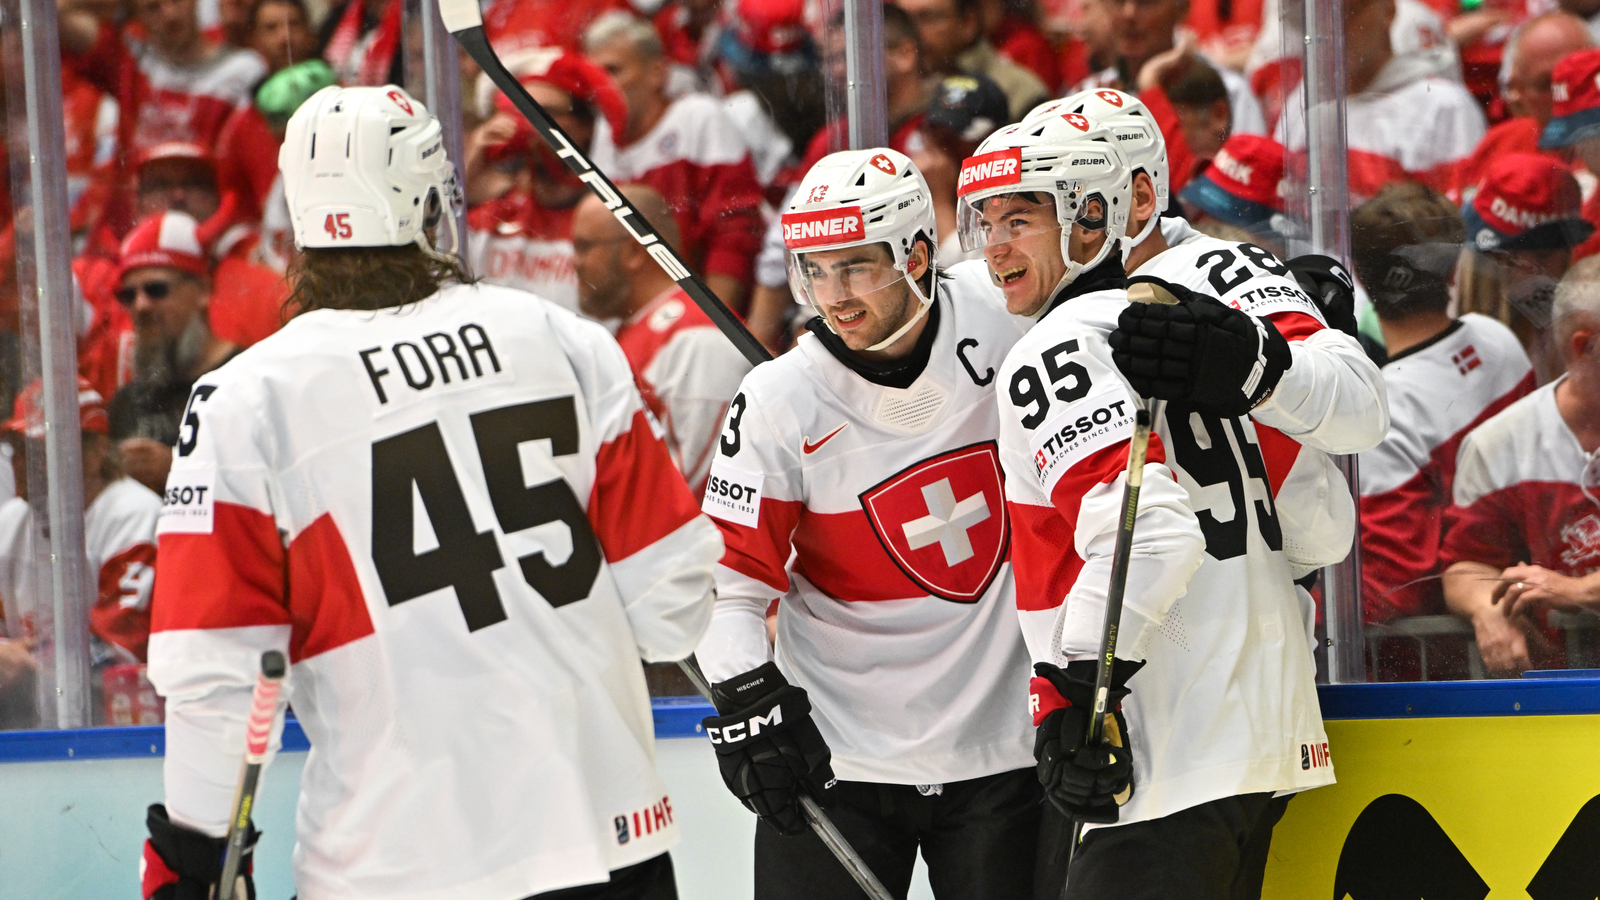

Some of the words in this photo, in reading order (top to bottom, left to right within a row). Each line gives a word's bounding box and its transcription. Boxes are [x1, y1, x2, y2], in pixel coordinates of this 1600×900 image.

[958, 158, 1018, 190] DENNER
[324, 213, 352, 239] 45
[549, 128, 691, 281] TRUE
[784, 216, 859, 240] DENNER
[1195, 242, 1290, 297] 28
[358, 322, 502, 405] FORA
[956, 337, 995, 387] C
[1008, 338, 1093, 431] 95
[720, 391, 747, 458] 3
[1042, 399, 1126, 456] TISSOT
[1049, 441, 1080, 469] WATCHES
[1082, 426, 1110, 443] SINCE
[1113, 416, 1136, 429] 1853
[1164, 398, 1284, 562] 95
[371, 395, 603, 633] 45
[737, 677, 765, 692] HISCHIER
[707, 704, 783, 744] CCM
[633, 794, 673, 838] IIHF
